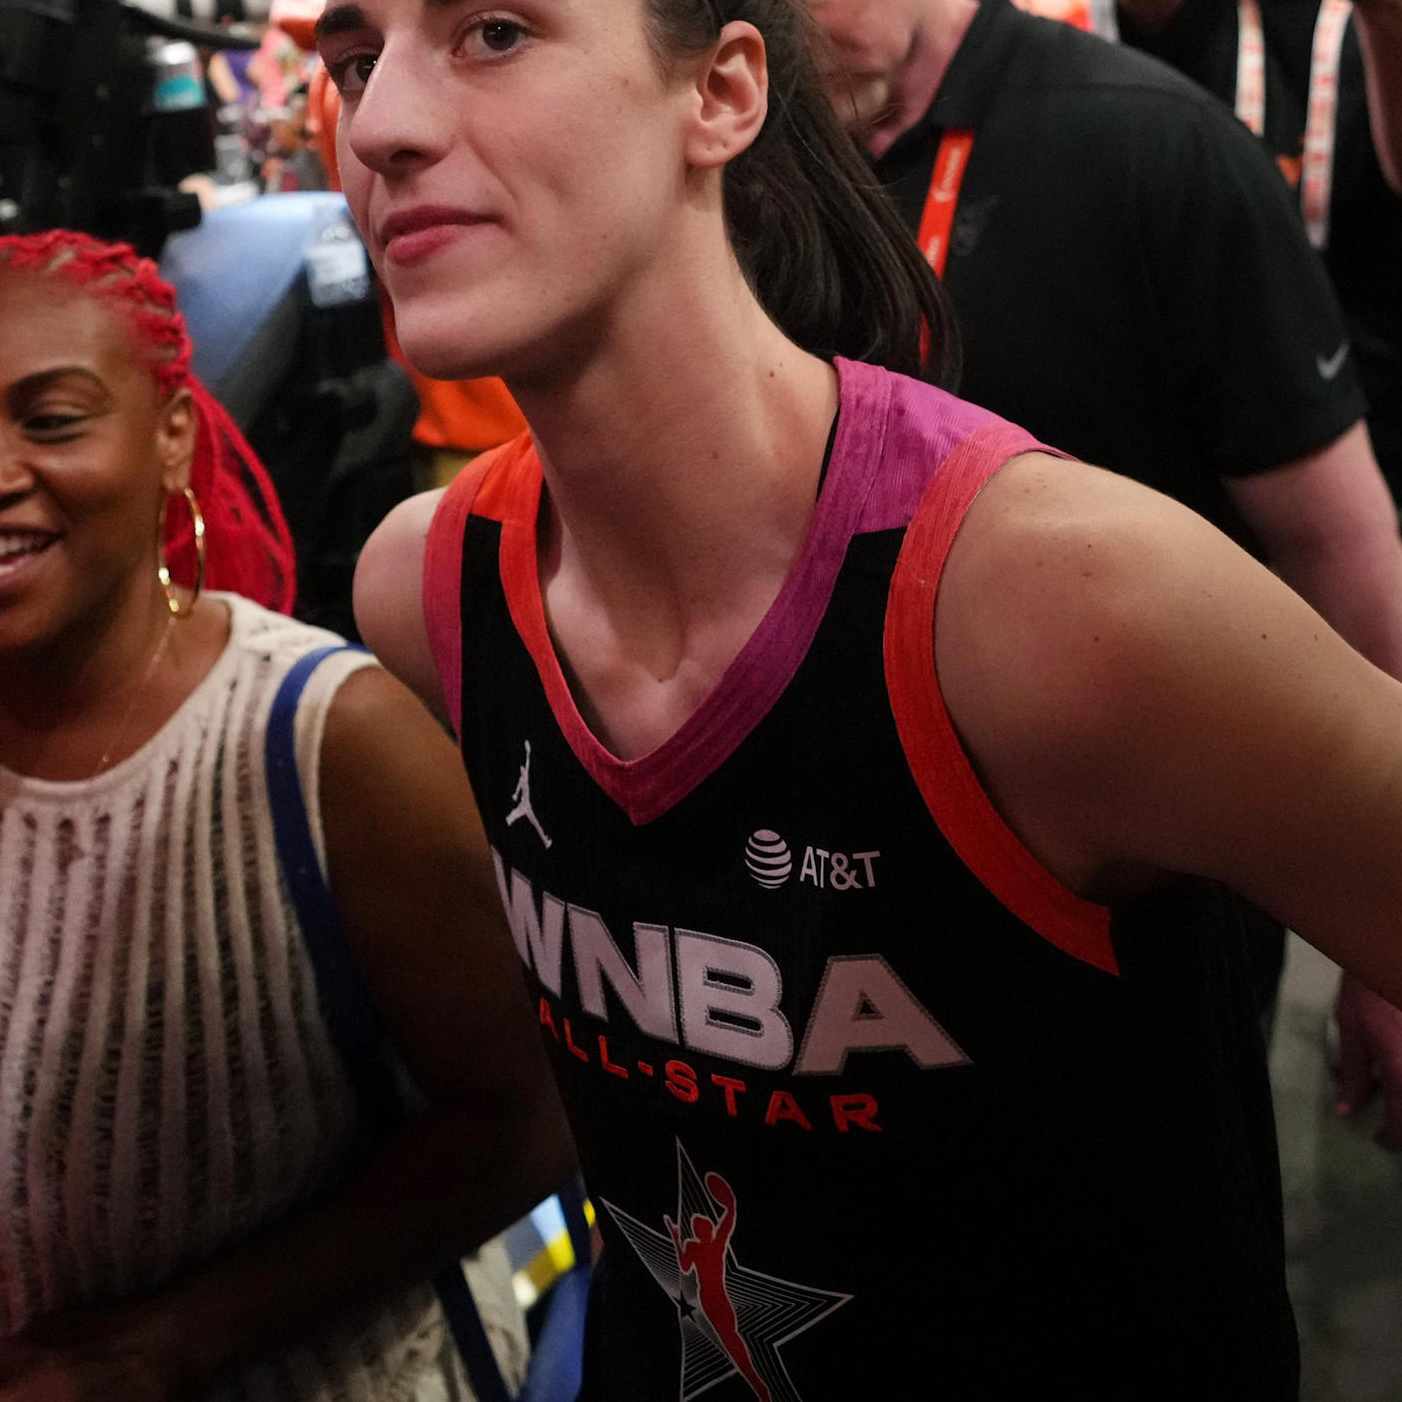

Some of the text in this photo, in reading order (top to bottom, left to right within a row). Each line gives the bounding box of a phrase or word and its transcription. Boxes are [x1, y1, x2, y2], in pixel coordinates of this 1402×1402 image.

[800, 846, 881, 891] AT&T
[491, 844, 975, 1077] WNBA
[538, 997, 884, 1133] ALL-STAR
